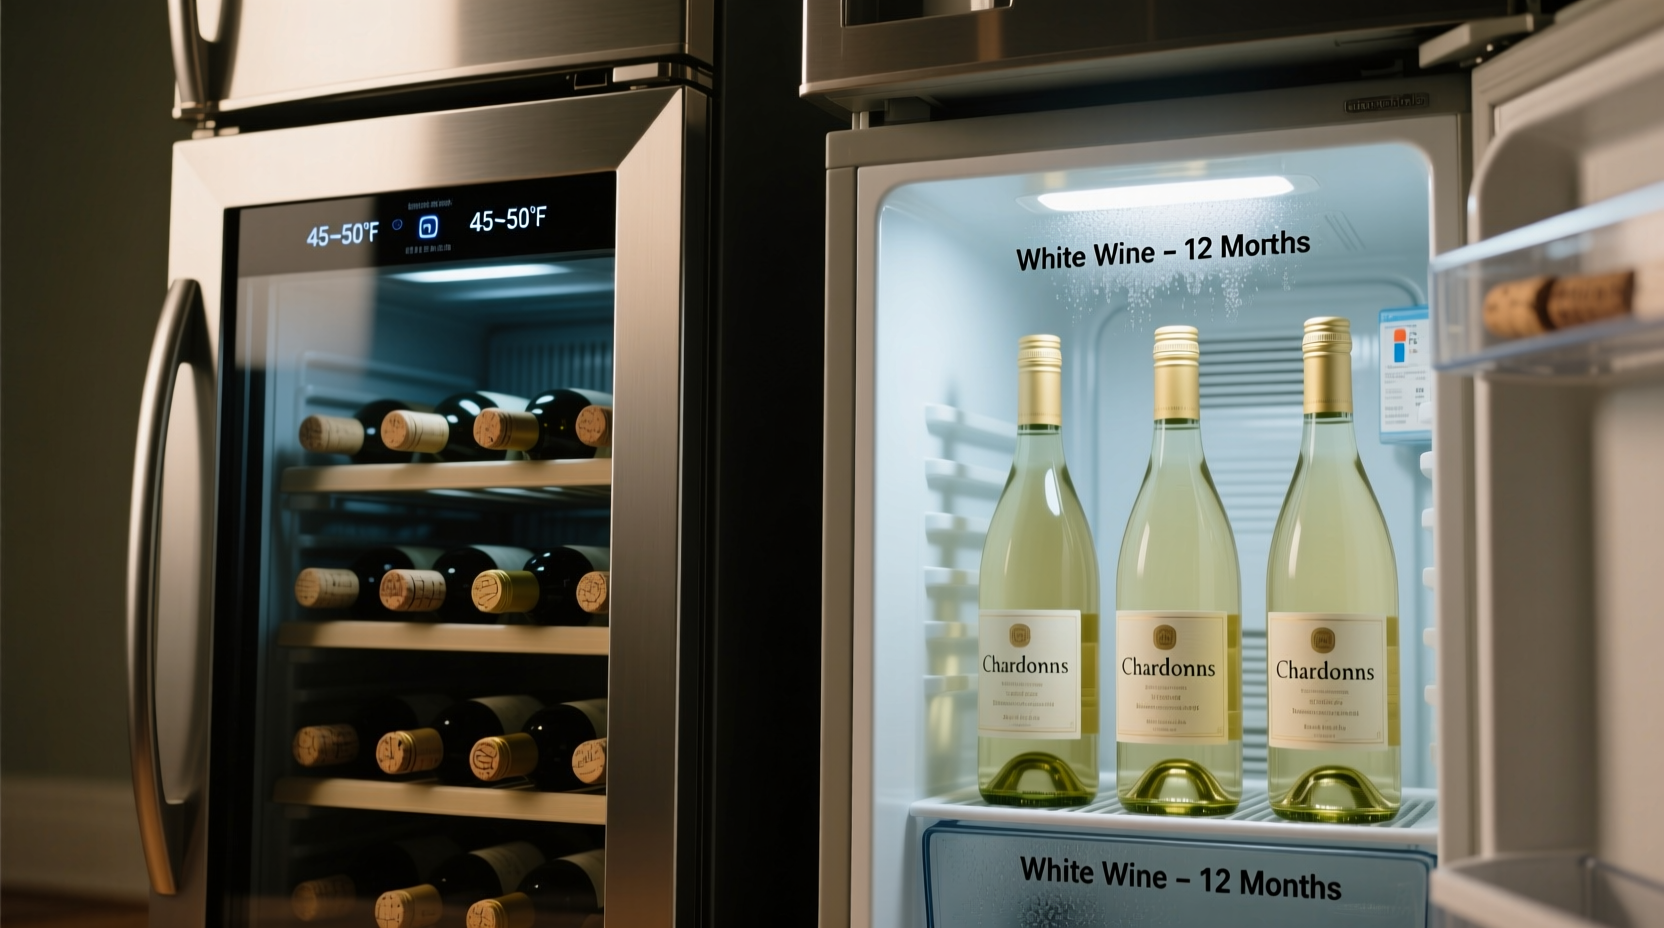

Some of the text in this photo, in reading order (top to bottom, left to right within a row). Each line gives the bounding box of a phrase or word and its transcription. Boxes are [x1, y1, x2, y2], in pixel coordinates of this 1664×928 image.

[1016, 246, 1086, 271] White
[1093, 242, 1155, 267] Wine
[1184, 236, 1213, 260] 12
[982, 654, 1069, 674] Chardonns
[1121, 656, 1216, 677] Chardonns
[1276, 659, 1375, 681] Chardonns
[1020, 855, 1094, 885] White
[1101, 860, 1167, 889] Wine
[1199, 867, 1231, 894] 12
[1240, 869, 1342, 901] Months
